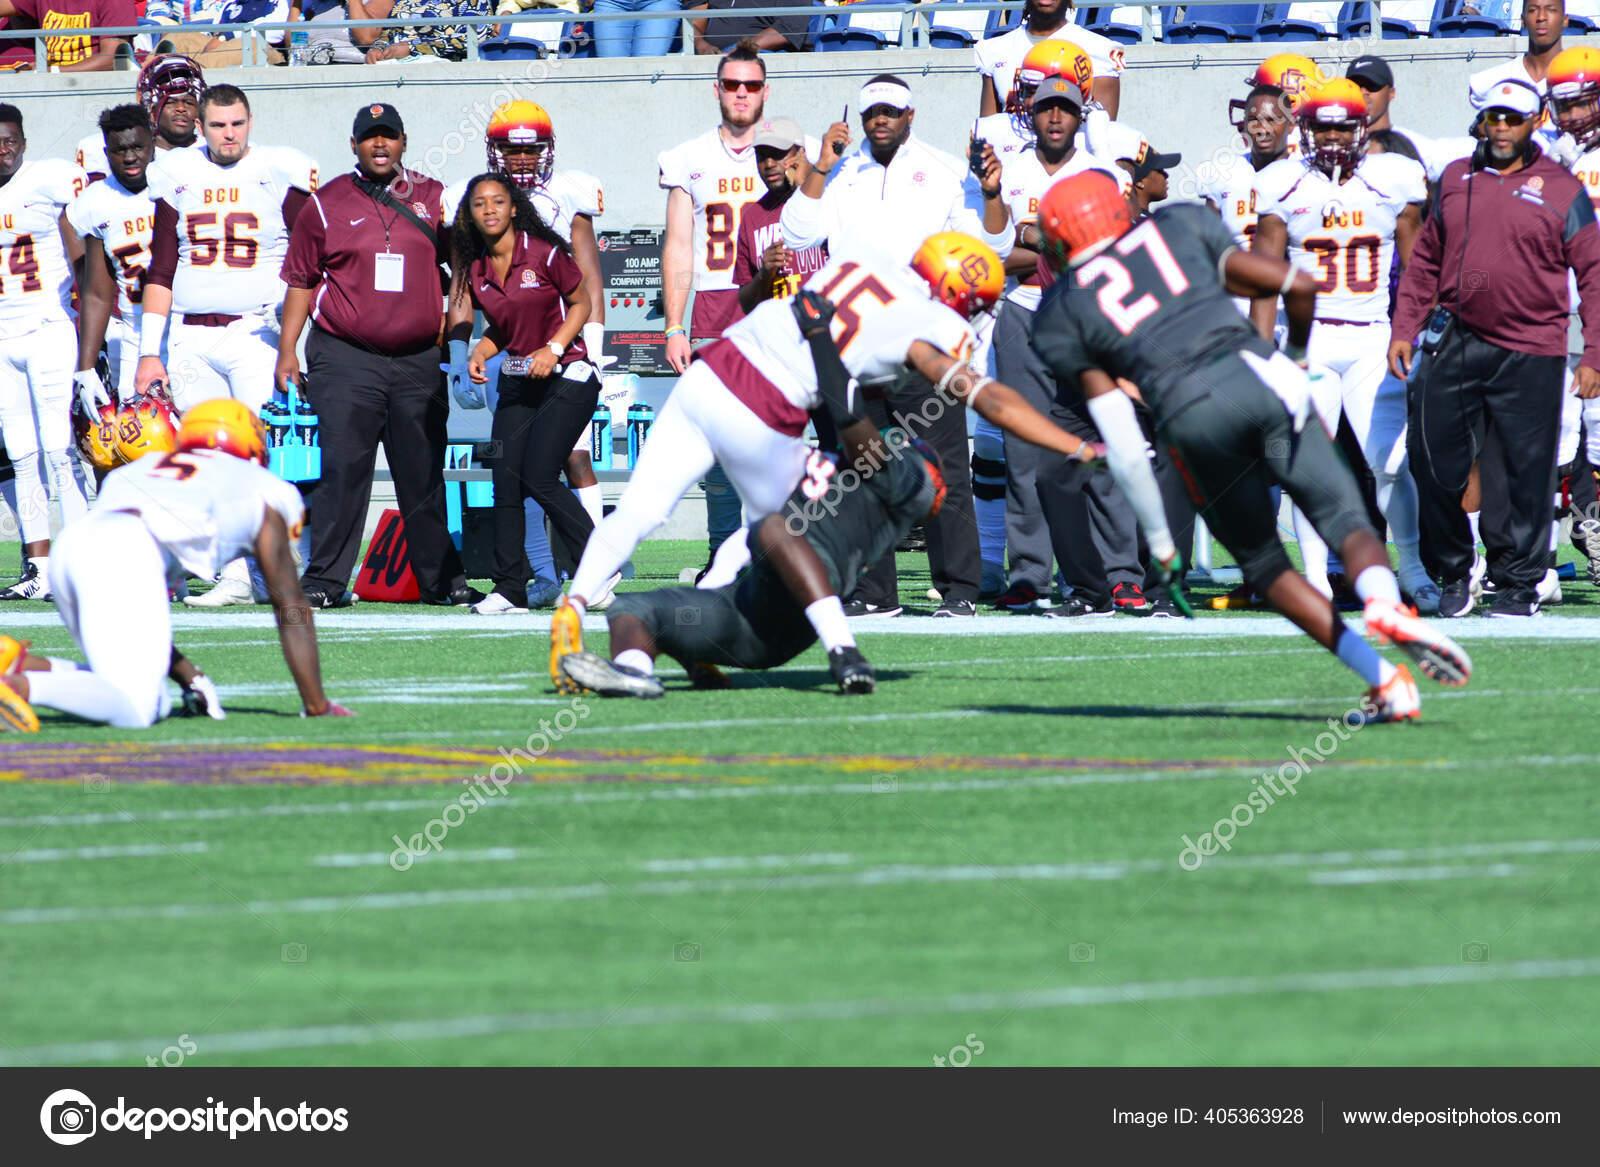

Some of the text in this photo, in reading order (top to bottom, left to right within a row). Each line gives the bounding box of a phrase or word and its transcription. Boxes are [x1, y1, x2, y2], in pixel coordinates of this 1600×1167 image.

[203, 187, 239, 205] BCU
[718, 177, 754, 194] BCU
[186, 211, 260, 269] 56
[624, 257, 660, 268] 100 AMP
[1302, 235, 1381, 293] 30
[112, 243, 152, 304] 5
[611, 277, 644, 286] COMPANY
[1076, 219, 1190, 335] 27
[817, 262, 898, 357] 15
[365, 515, 410, 588] 40
